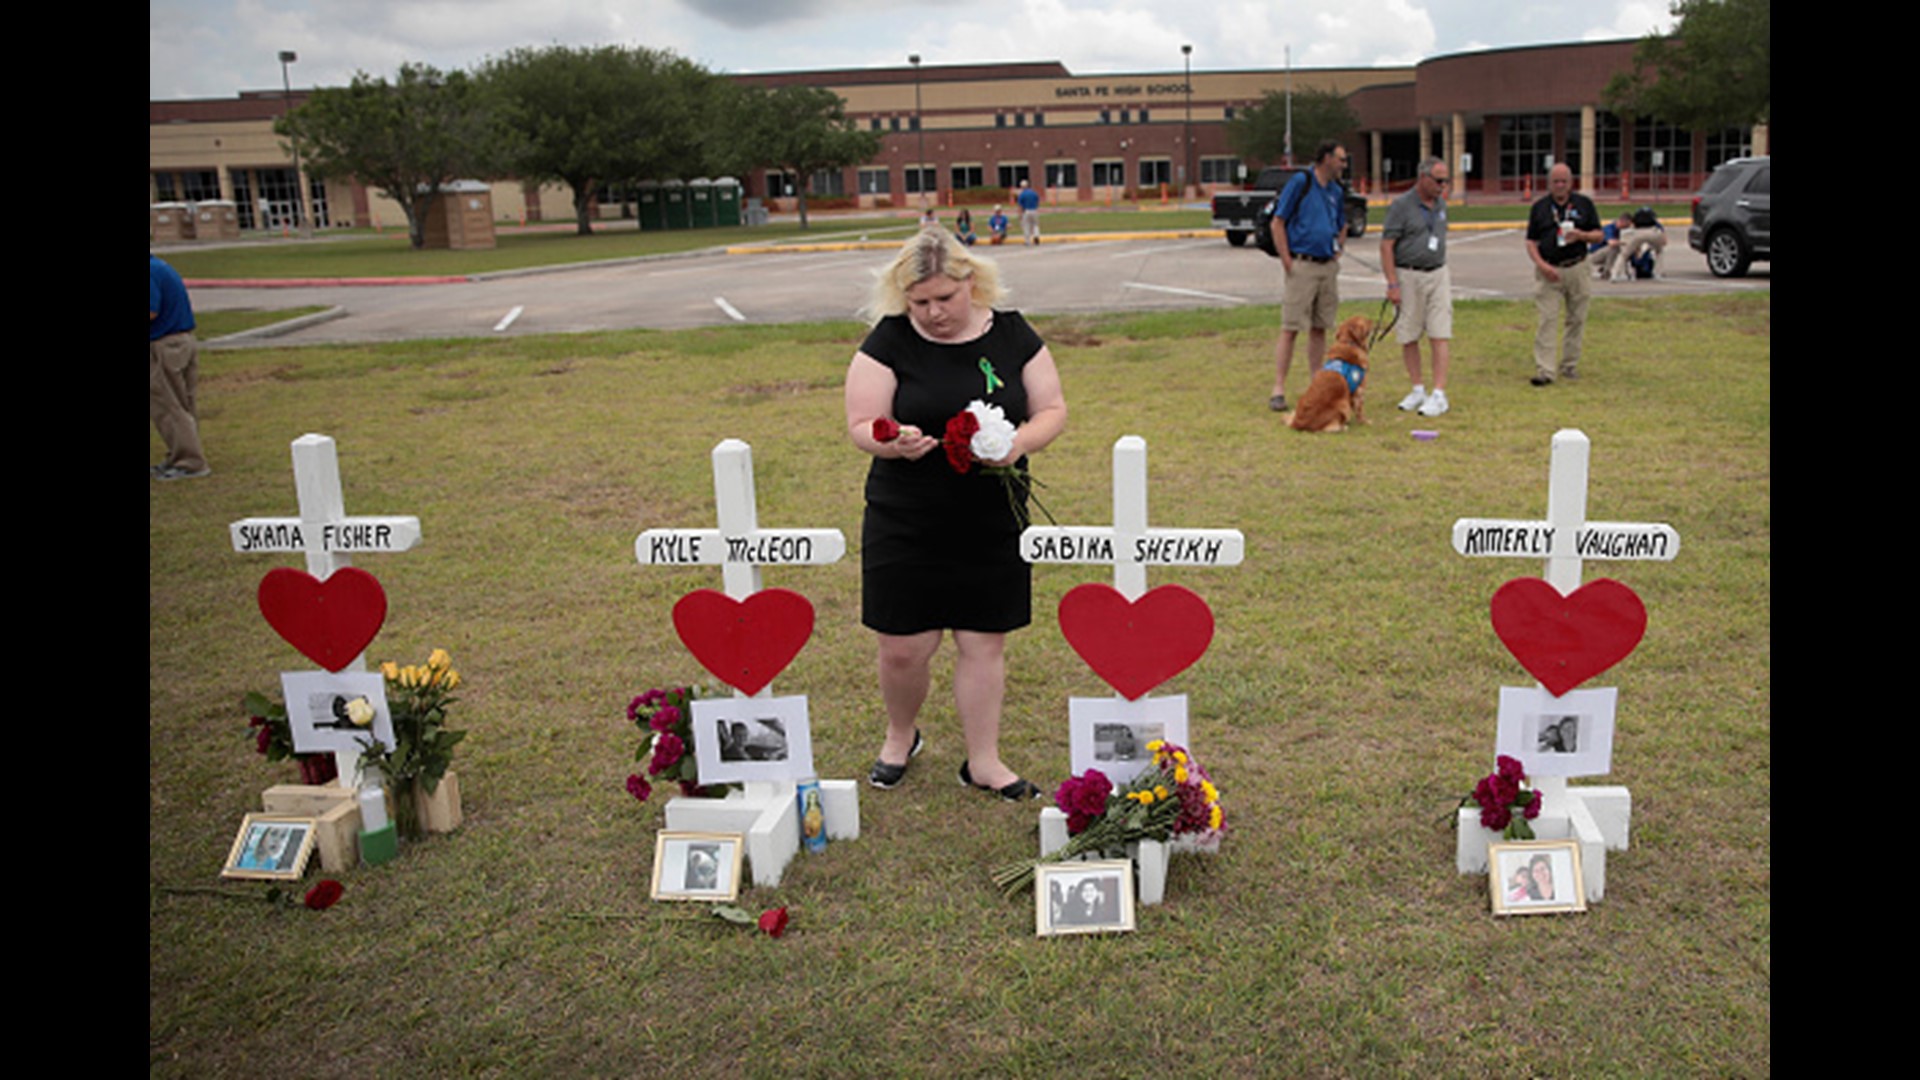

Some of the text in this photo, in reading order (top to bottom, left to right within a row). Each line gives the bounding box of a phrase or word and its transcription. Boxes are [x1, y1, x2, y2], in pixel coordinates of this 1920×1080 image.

[1055, 83, 1194, 97] SANTA FE HIGH SCHOOL
[239, 524, 392, 550] SHANA FISHER
[650, 534, 812, 564] KYLE McLEON
[1030, 536, 1223, 563] SABIKA SHEIKH
[1465, 527, 1669, 557] KIMERLY VAUGHAN
